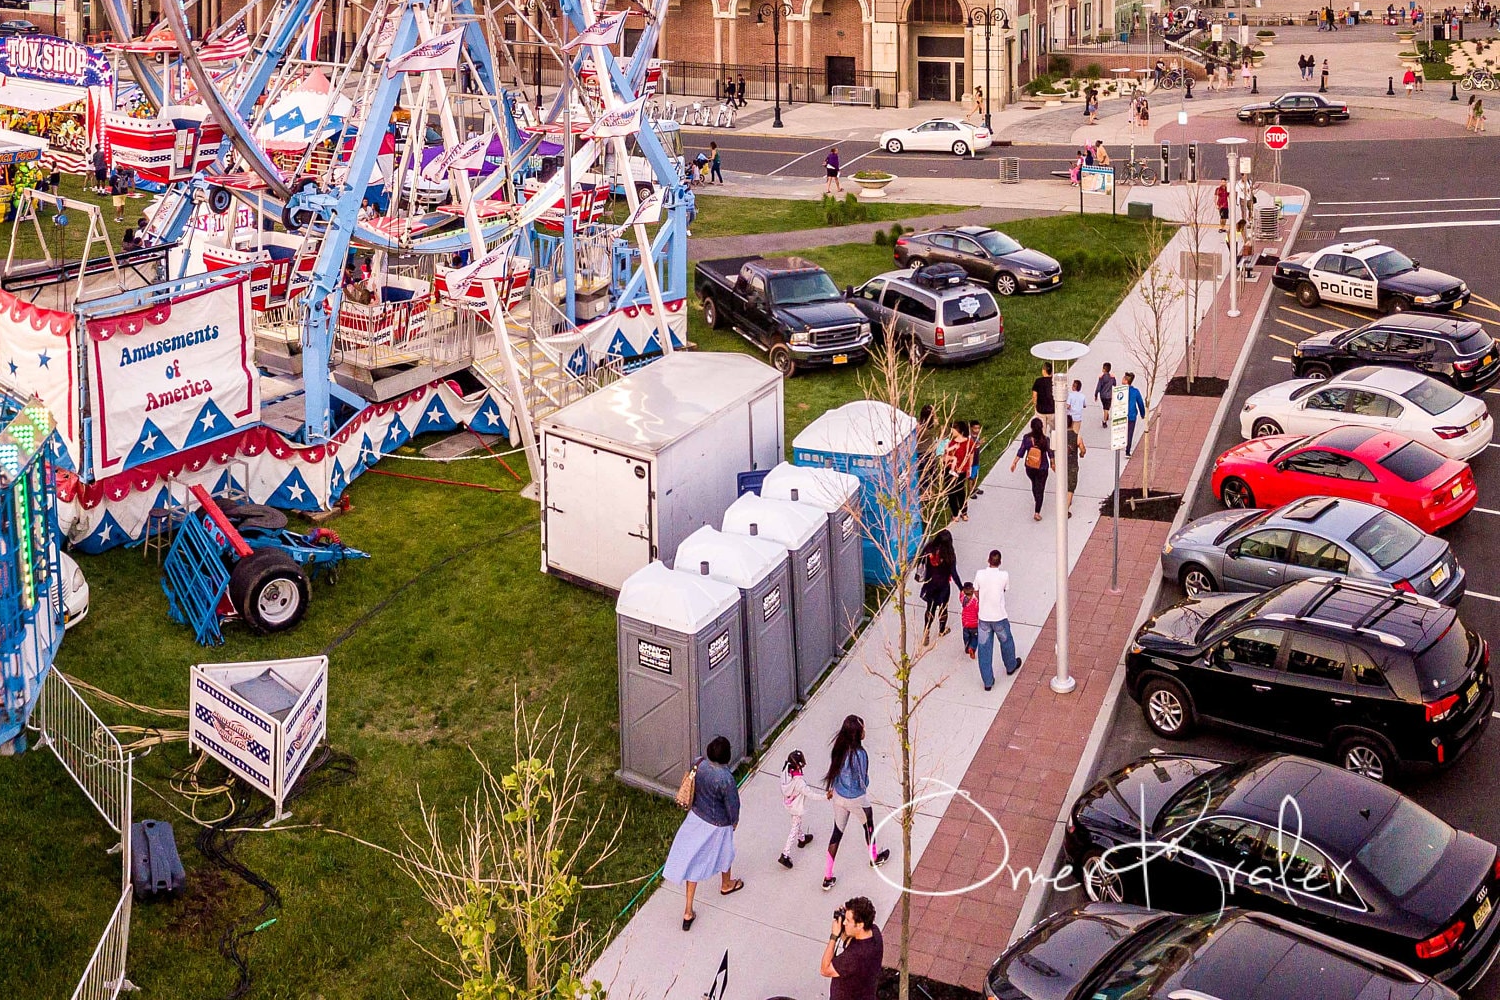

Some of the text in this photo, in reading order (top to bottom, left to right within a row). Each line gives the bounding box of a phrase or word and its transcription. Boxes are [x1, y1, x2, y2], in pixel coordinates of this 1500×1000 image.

[6, 38, 88, 76] TOY SHOP
[1266, 133, 1287, 142] STOP
[15, 150, 40, 161] POND
[1320, 281, 1373, 300] POLICE
[119, 324, 219, 367] Amusements
[165, 359, 181, 379] of
[145, 379, 213, 412] America
